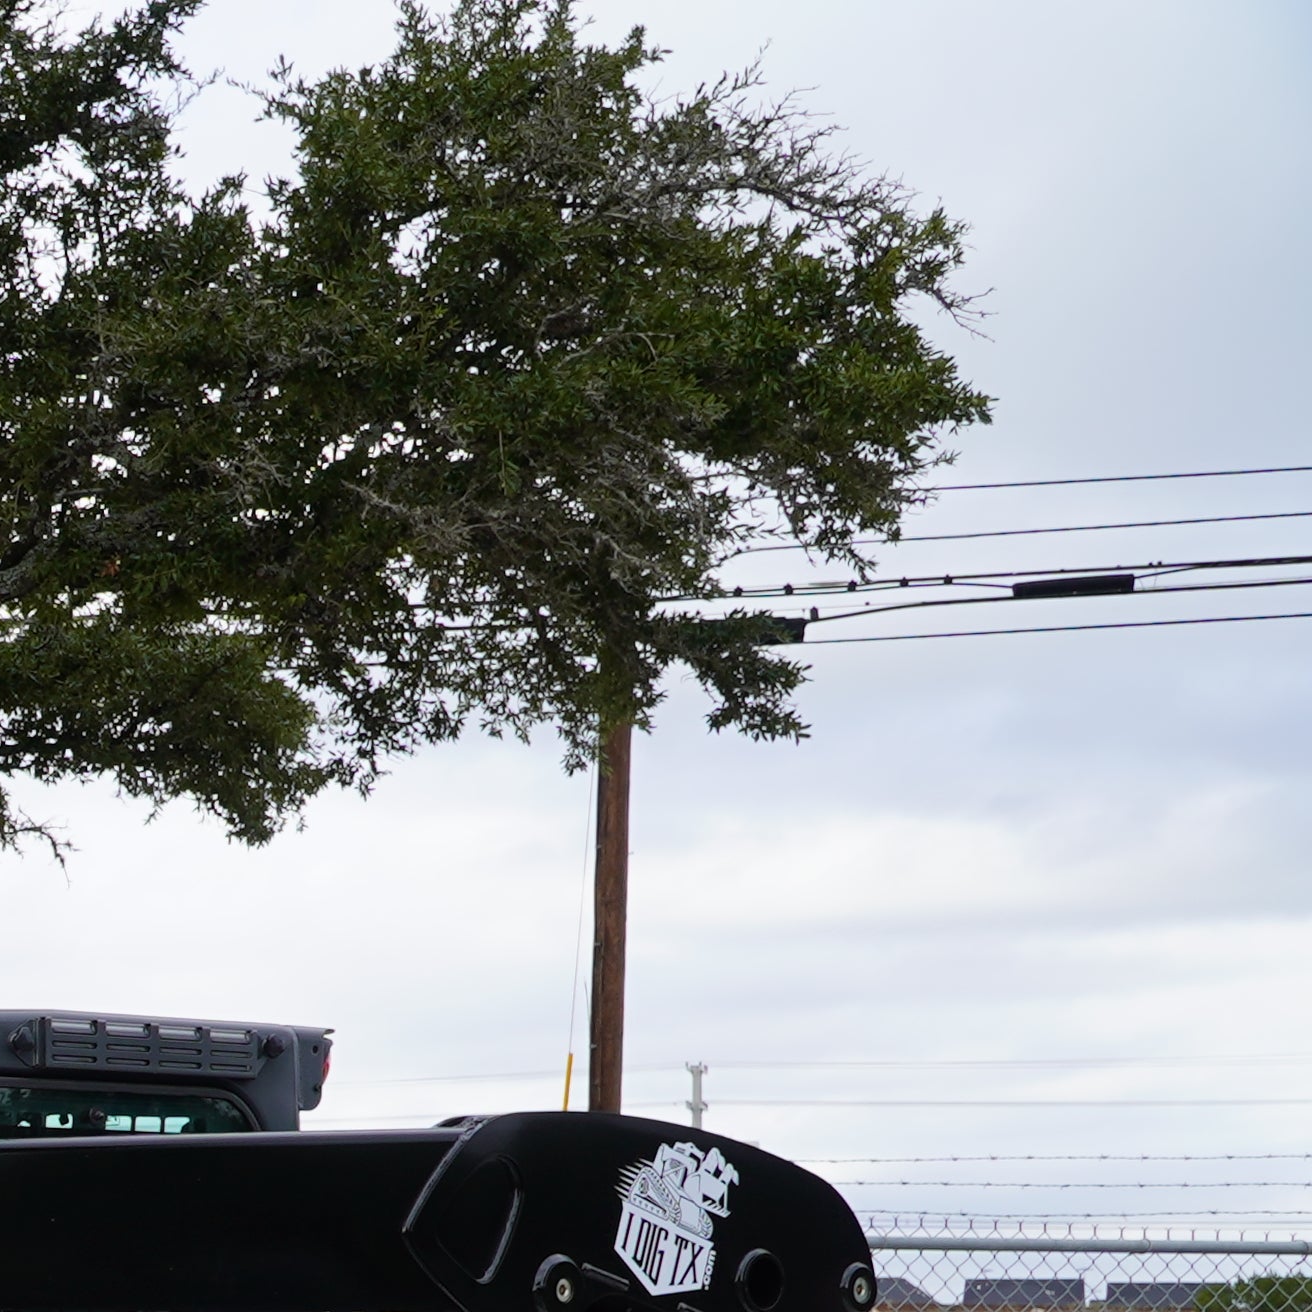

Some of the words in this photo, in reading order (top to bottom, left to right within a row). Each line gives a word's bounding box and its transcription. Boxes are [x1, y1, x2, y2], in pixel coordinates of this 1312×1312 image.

[621, 1212, 634, 1252] I
[632, 1218, 669, 1286] DIG
[670, 1234, 704, 1286] TX
[704, 1250, 717, 1291] .com
